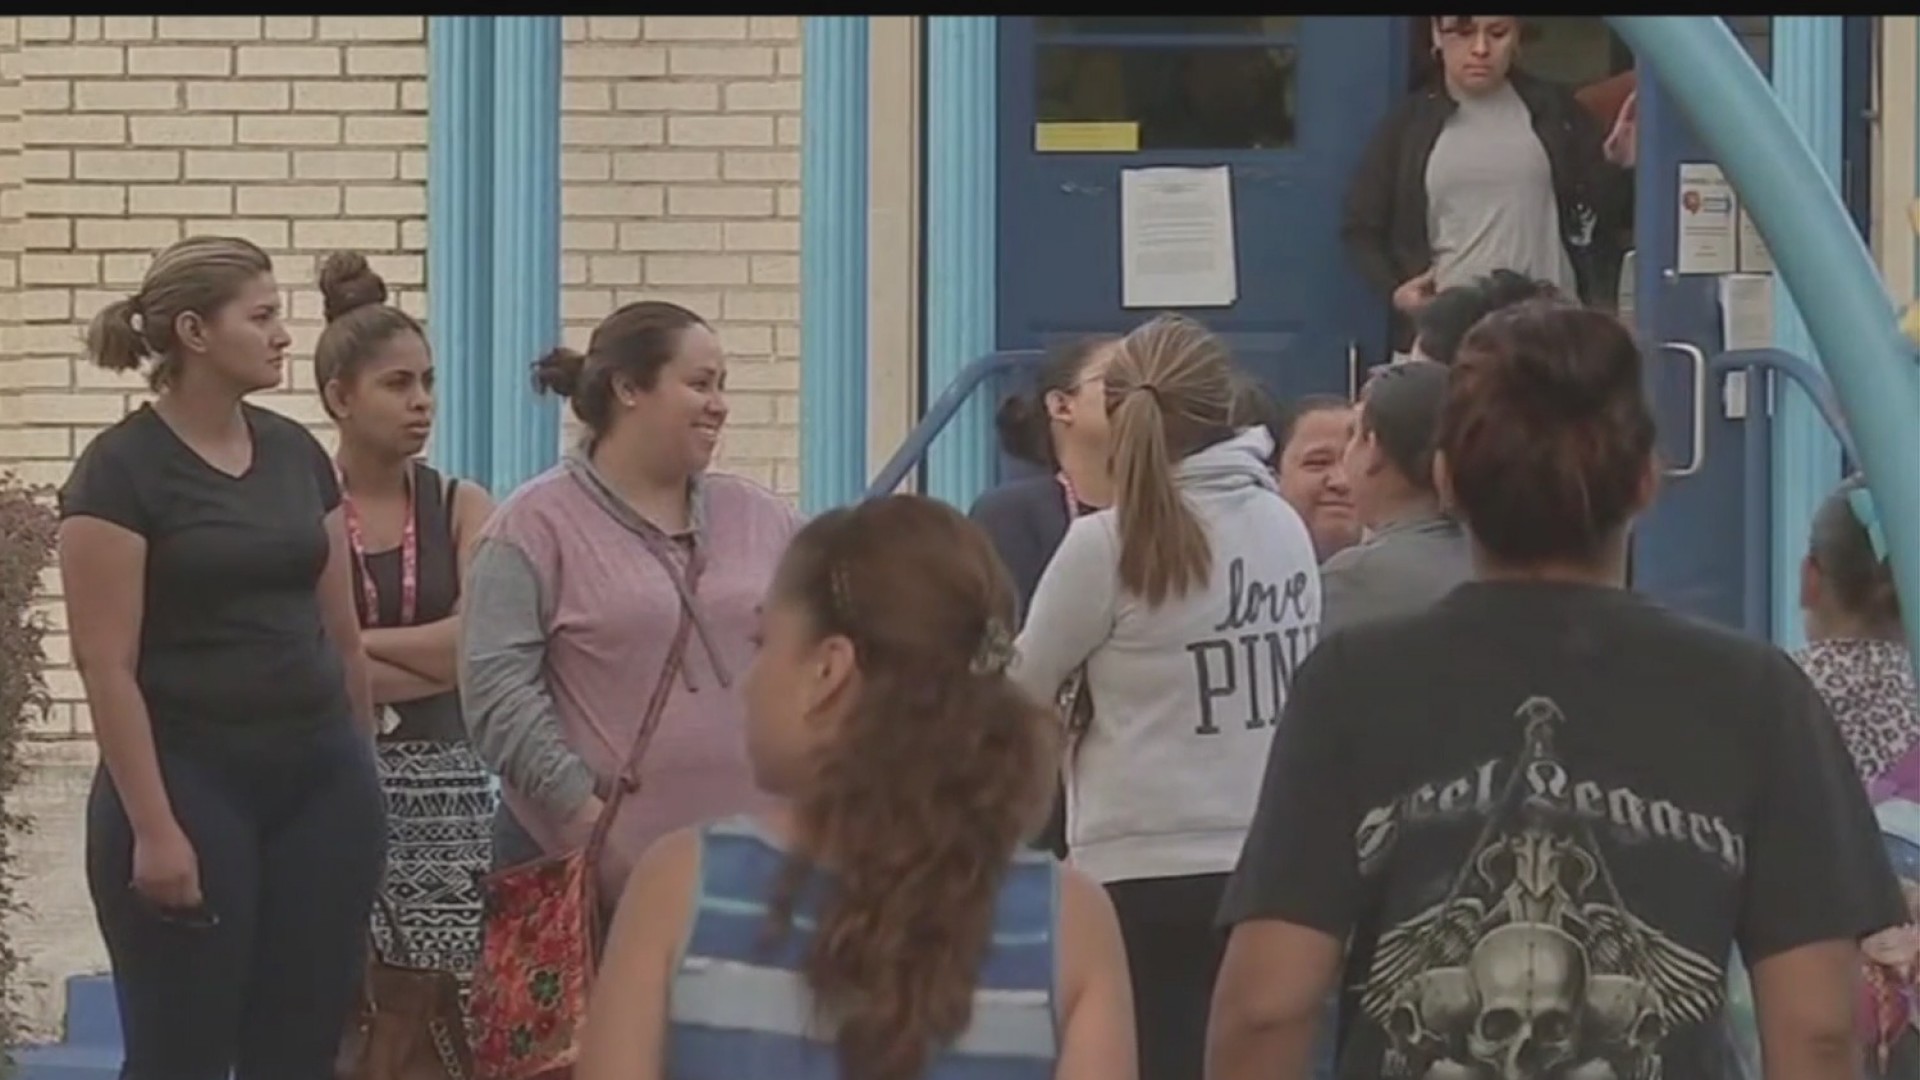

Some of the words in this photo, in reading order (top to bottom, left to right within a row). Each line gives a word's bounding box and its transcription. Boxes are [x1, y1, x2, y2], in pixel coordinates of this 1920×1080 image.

[1214, 556, 1308, 632] love
[1186, 624, 1318, 735] PIN
[1355, 759, 1501, 873] Seel
